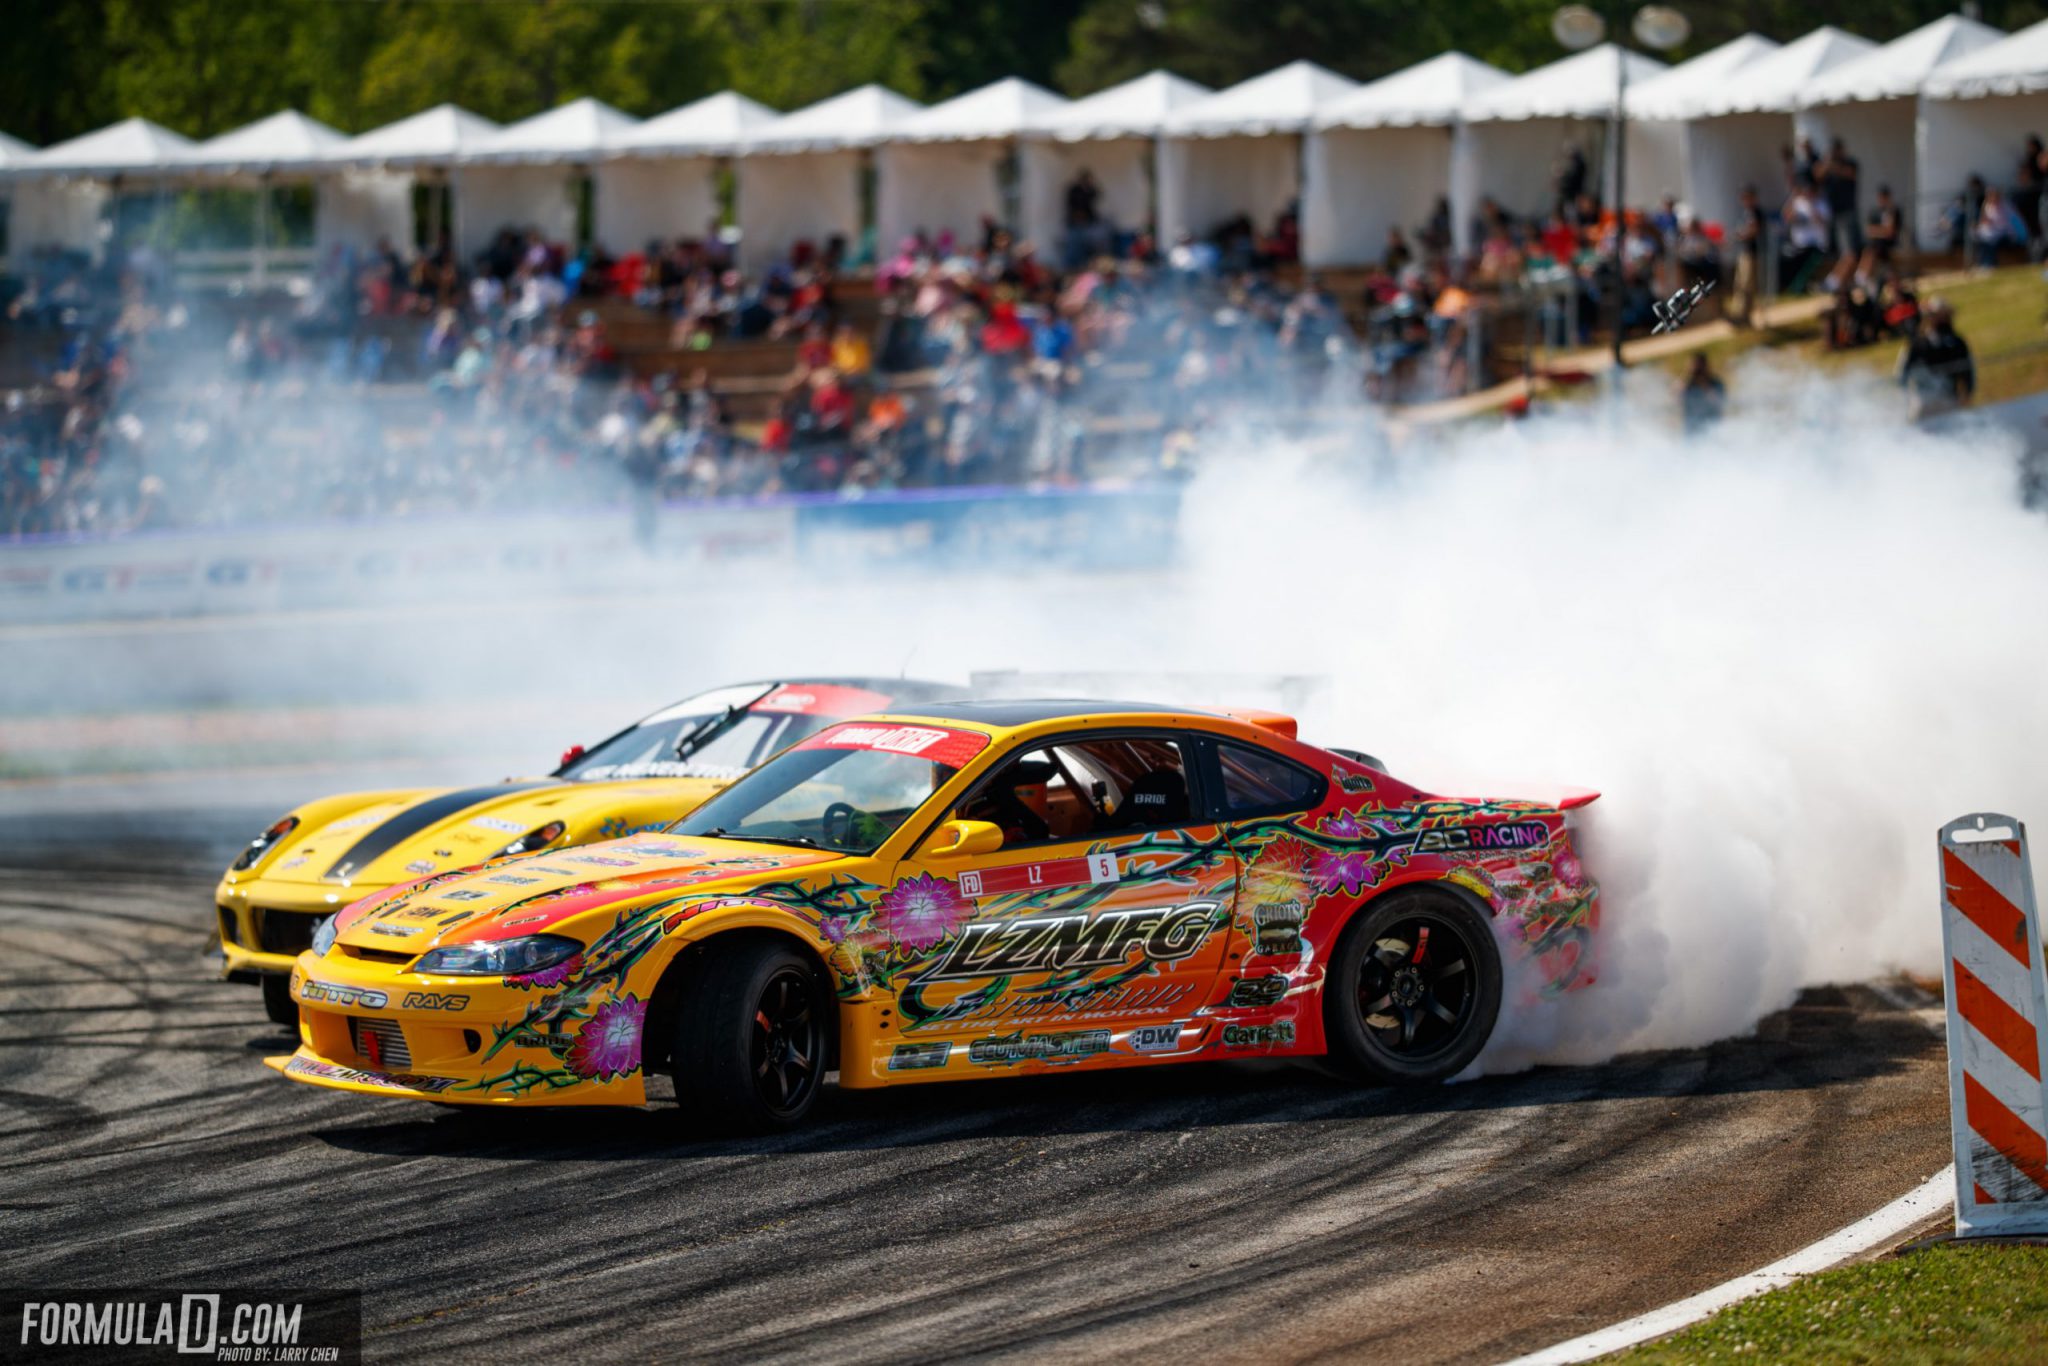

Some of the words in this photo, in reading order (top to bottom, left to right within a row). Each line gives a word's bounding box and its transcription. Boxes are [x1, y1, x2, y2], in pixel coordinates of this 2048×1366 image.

[1028, 866, 1042, 885] LZ
[1100, 858, 1109, 878] 5
[302, 979, 389, 1009] NITTO
[402, 991, 470, 1012] RAYS
